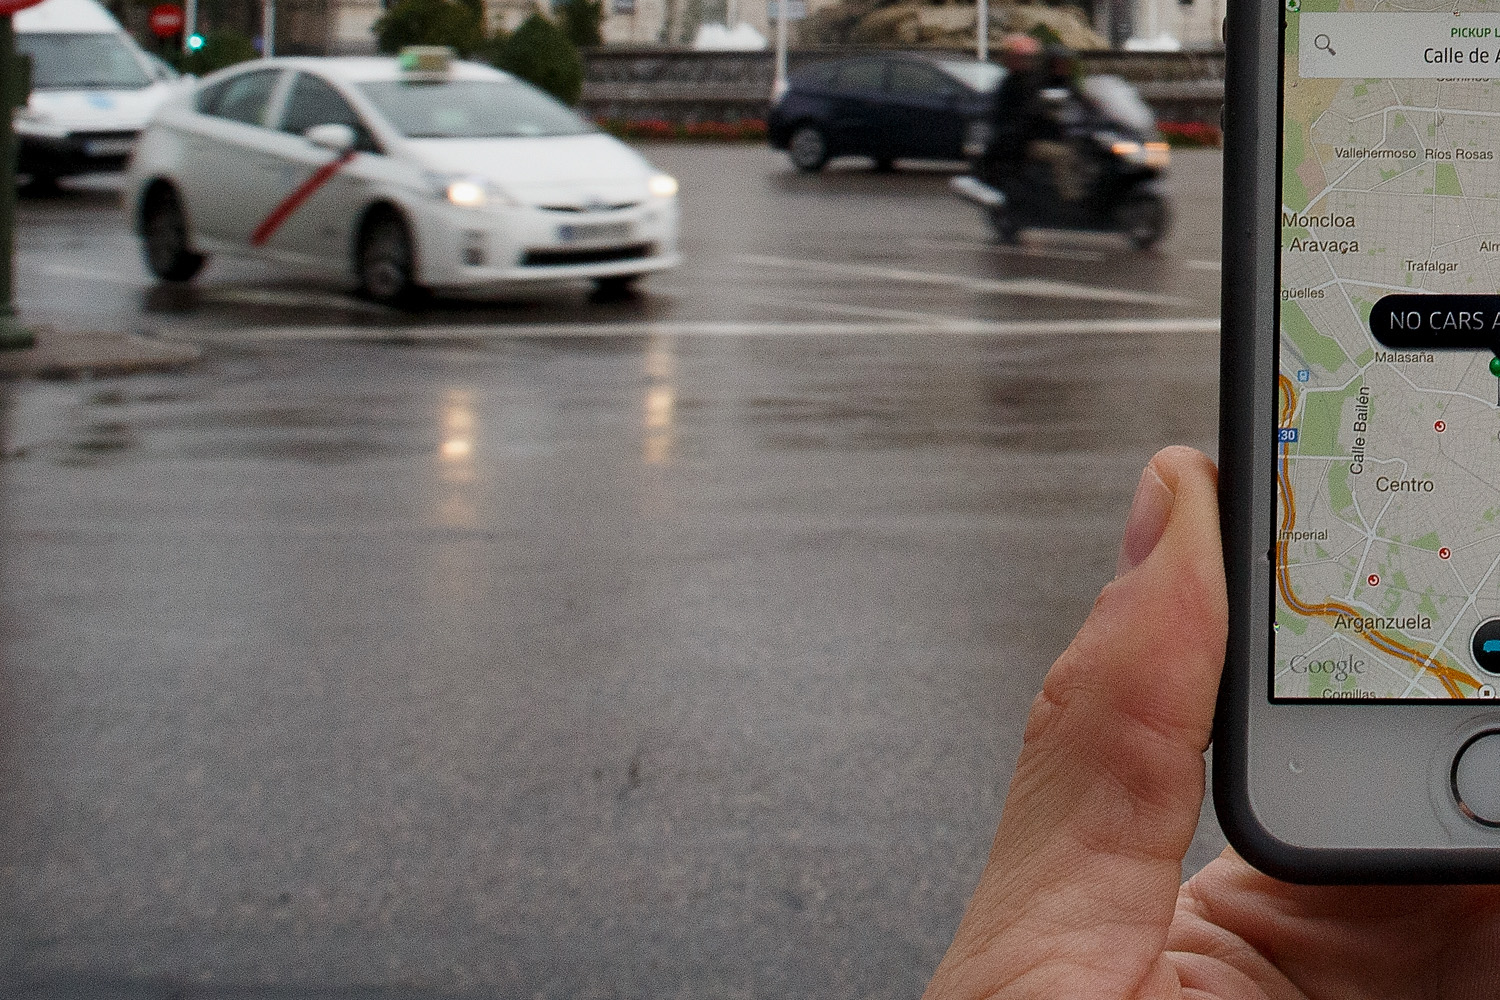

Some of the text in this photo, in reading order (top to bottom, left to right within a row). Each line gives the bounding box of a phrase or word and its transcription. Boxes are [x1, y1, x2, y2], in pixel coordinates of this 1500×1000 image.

[1450, 28, 1491, 38] PICKUP
[1424, 48, 1464, 64] Calle
[1469, 48, 1490, 64] de
[1335, 147, 1416, 159] Vallehermoso
[1425, 148, 1494, 160] Ríos Rosas
[1282, 213, 1355, 227] Moncloa
[1289, 237, 1359, 252] Aravaca
[1405, 260, 1458, 274] Trafalgar
[1390, 312, 1421, 330] NO
[1430, 312, 1484, 330] CARS
[1375, 352, 1434, 364] Malasaña
[1350, 387, 1370, 475] Calle Bailén
[1376, 476, 1434, 492] Centro
[1279, 529, 1328, 541] Imperial
[1334, 613, 1431, 633] Arganzuela
[1290, 654, 1365, 682] Google
[1322, 688, 1376, 699] Comillas
